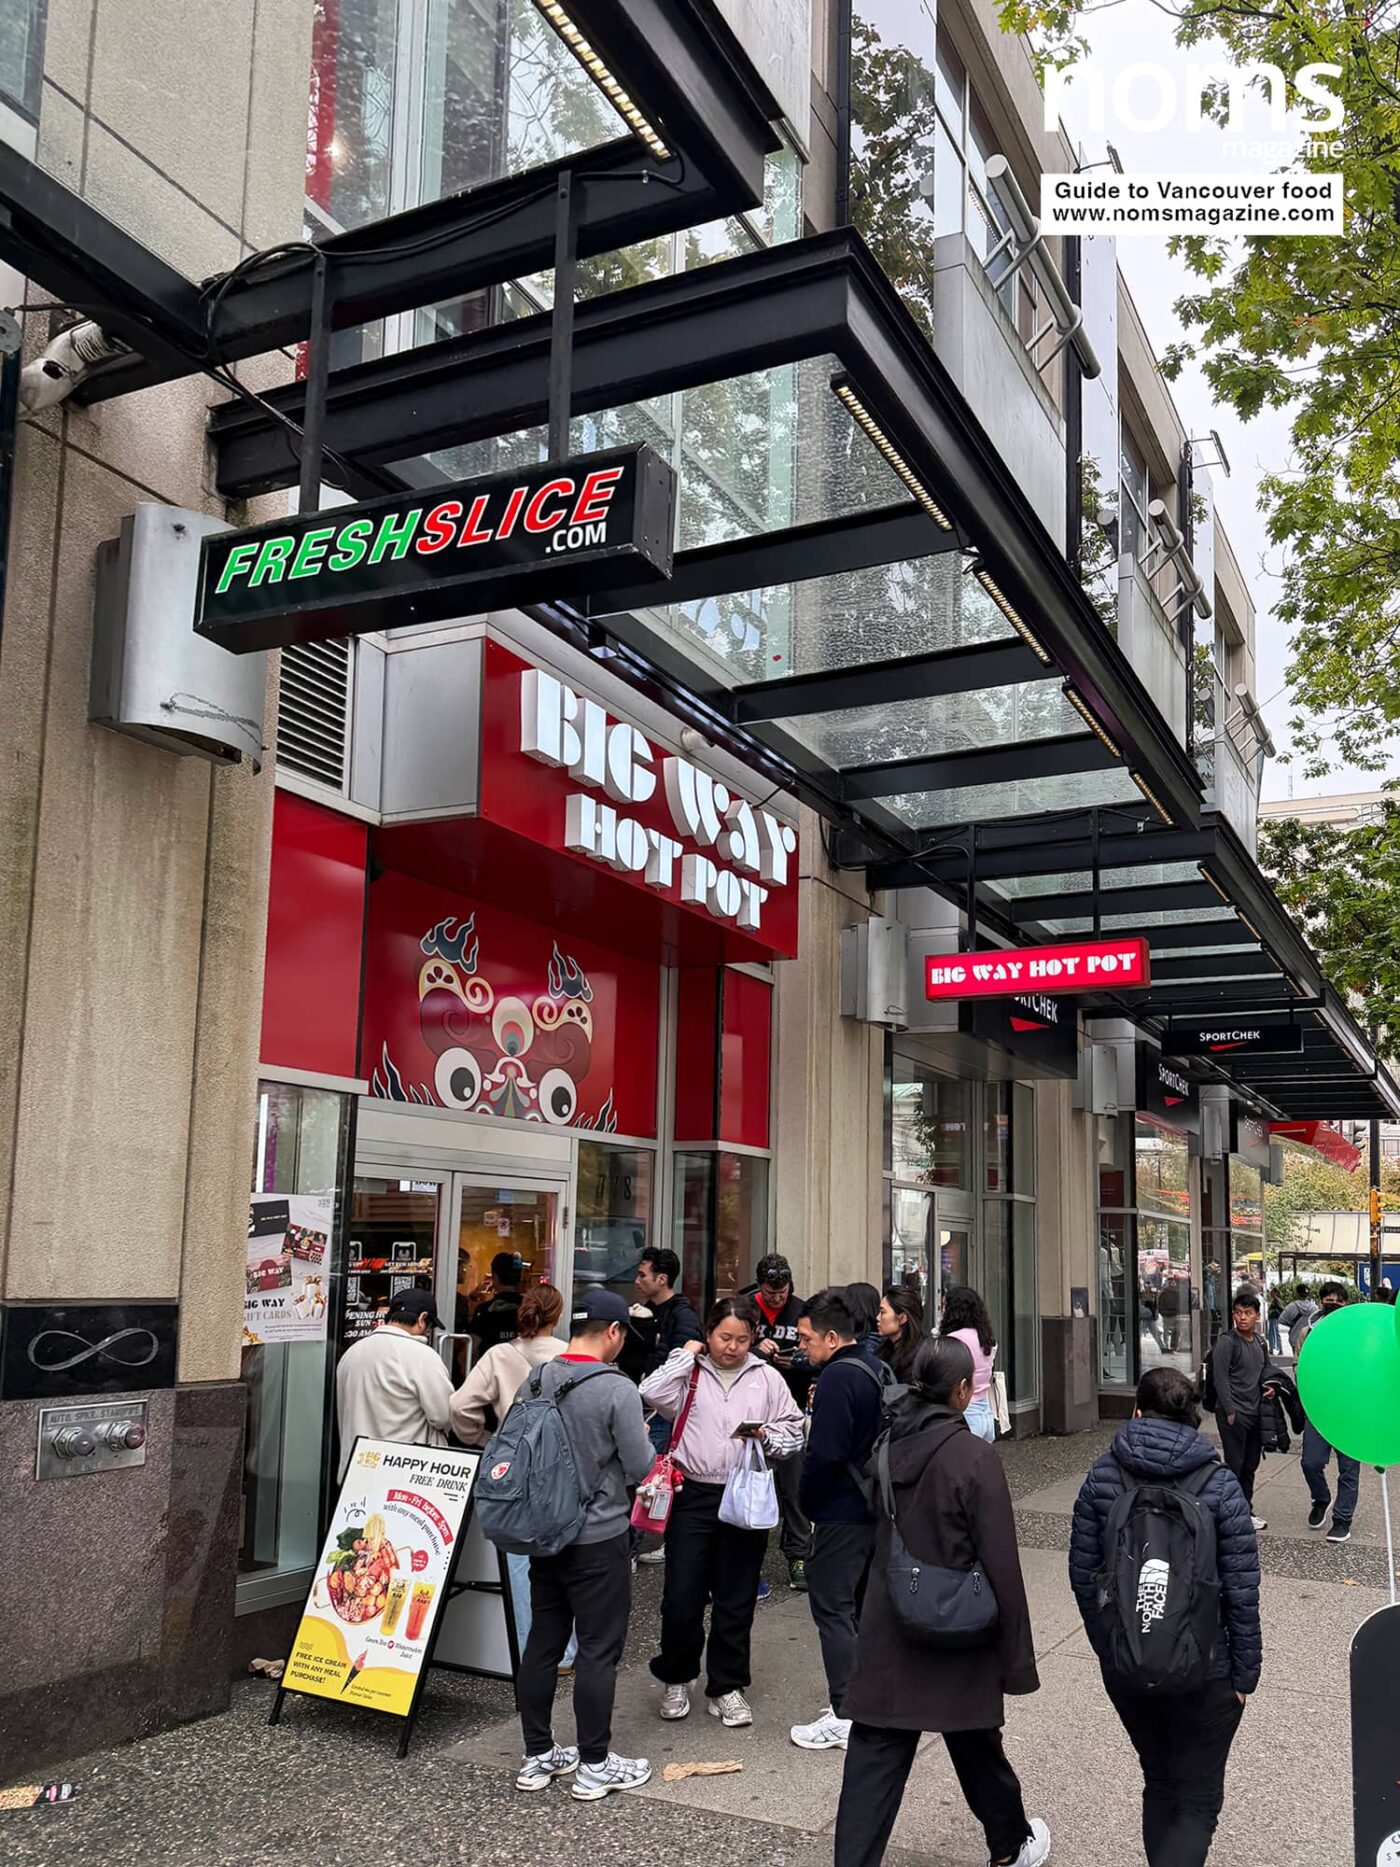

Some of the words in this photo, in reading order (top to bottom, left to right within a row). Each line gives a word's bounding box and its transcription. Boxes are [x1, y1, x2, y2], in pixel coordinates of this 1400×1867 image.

[214, 466, 625, 595] FRESHSLICE
[544, 521, 607, 554] .COM
[520, 668, 657, 803] BIG
[663, 756, 797, 886] WAY
[565, 793, 683, 893] HOT
[681, 853, 768, 931] POT
[931, 966, 966, 985] BIG
[972, 962, 1023, 981] WAY
[1029, 956, 1080, 978] HOT
[1087, 952, 1137, 974] POT
[1014, 995, 1058, 1023] TCHEK
[1199, 1030, 1261, 1042] SPORTCHEK
[243, 1312, 262, 1321] IFT
[263, 1310, 292, 1320] CARDS
[262, 1298, 285, 1308] WAY
[383, 1455, 428, 1471] HAPPY
[430, 1462, 471, 1478] HOUR
[409, 1474, 435, 1487] FREE
[436, 1478, 468, 1492] DRINK
[1136, 1585, 1146, 1613] THE
[1141, 1584, 1155, 1634] NORTH
[1152, 1584, 1168, 1619] FACE
[293, 1660, 310, 1670] WITH
[311, 1665, 324, 1673] ANY
[324, 1668, 341, 1678] MEAL
[296, 1652, 313, 1661] FREE
[325, 1658, 347, 1668] CREAM
